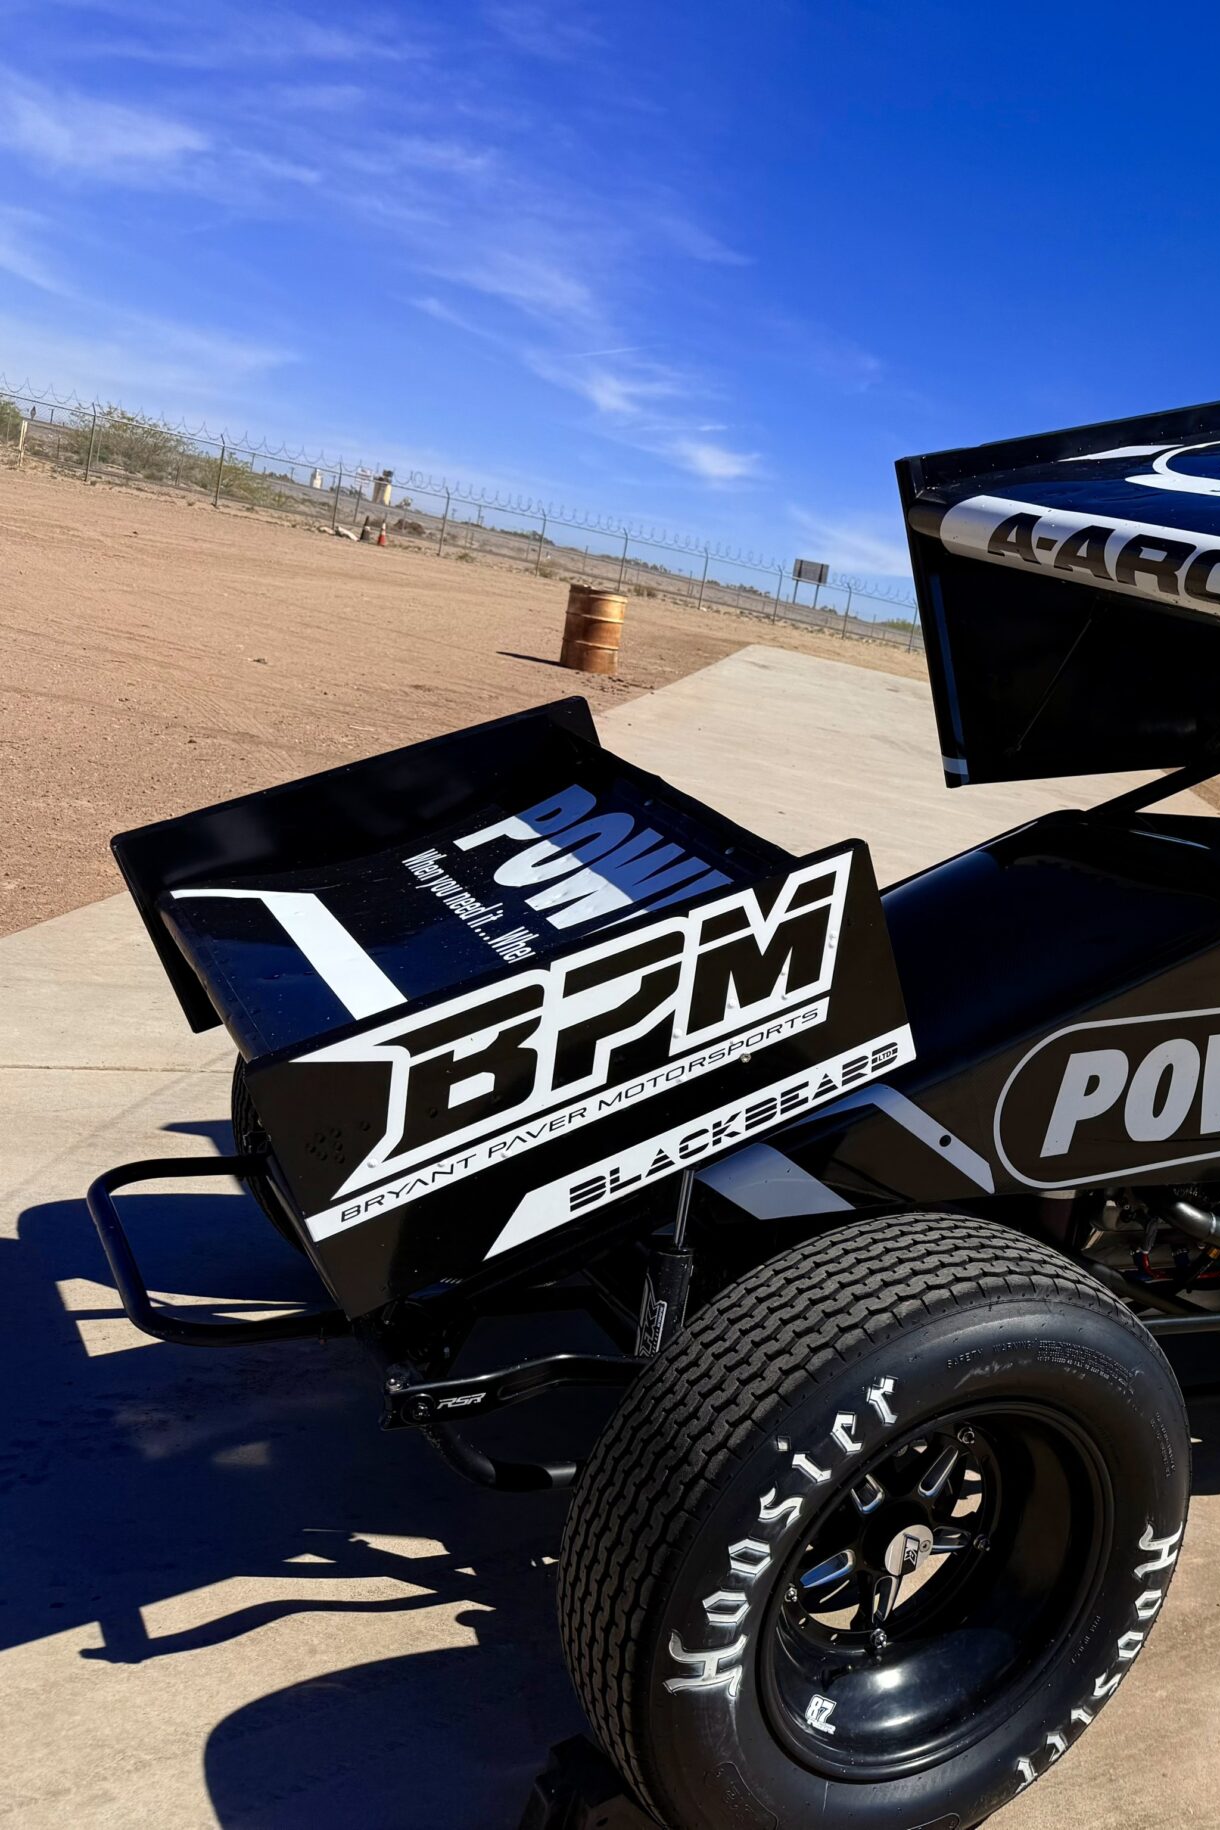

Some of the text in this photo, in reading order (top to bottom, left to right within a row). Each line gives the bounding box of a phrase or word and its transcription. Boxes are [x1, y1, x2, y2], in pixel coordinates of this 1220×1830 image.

[402, 848, 447, 881] When
[416, 874, 463, 897] you
[443, 891, 503, 920] need
[380, 866, 840, 1162] BPM
[340, 1007, 819, 1223] BRYANT PAVER MOTORSPORTS
[569, 1041, 899, 1213] BLACKBEARD LTD
[663, 1376, 898, 1698] Hoosier
[805, 1694, 837, 1722] 87
